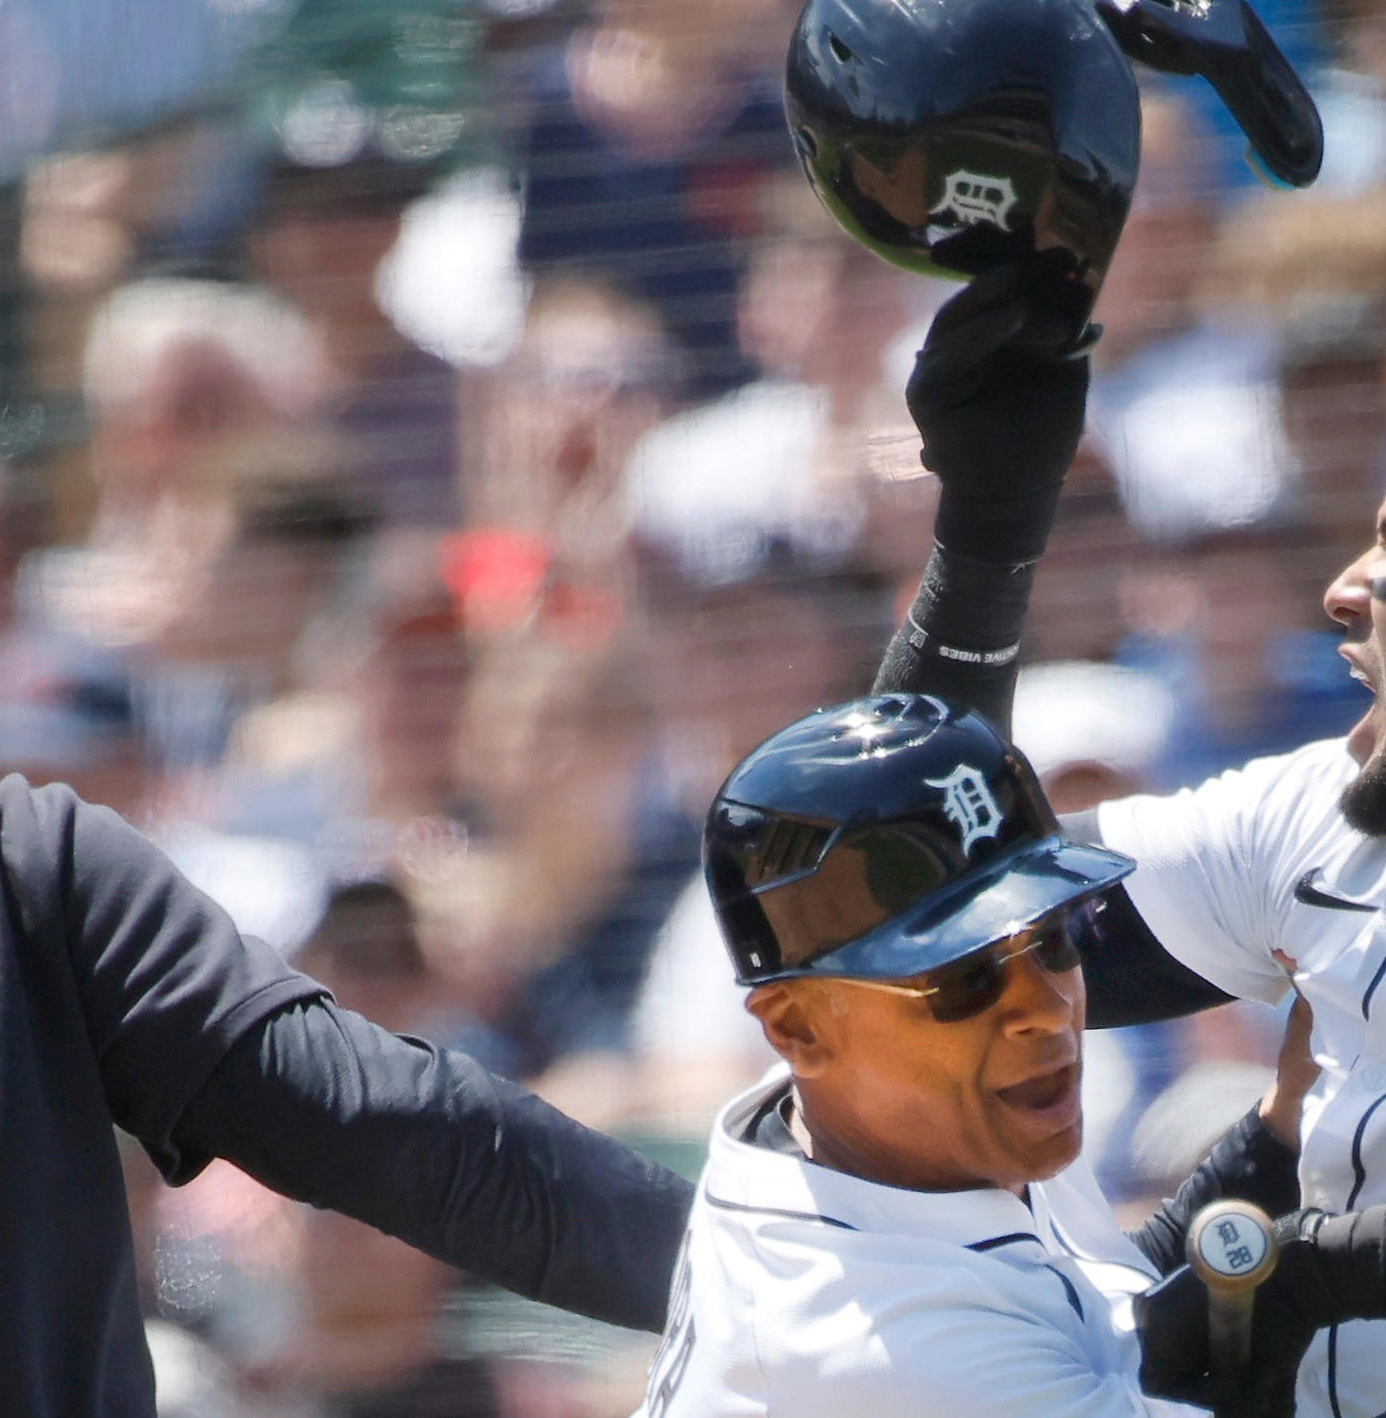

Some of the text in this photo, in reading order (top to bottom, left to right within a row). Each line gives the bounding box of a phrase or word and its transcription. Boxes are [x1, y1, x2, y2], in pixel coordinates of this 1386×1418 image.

[939, 646, 981, 663] VIBES
[924, 763, 1004, 858] D
[1225, 1245, 1254, 1270] 28
